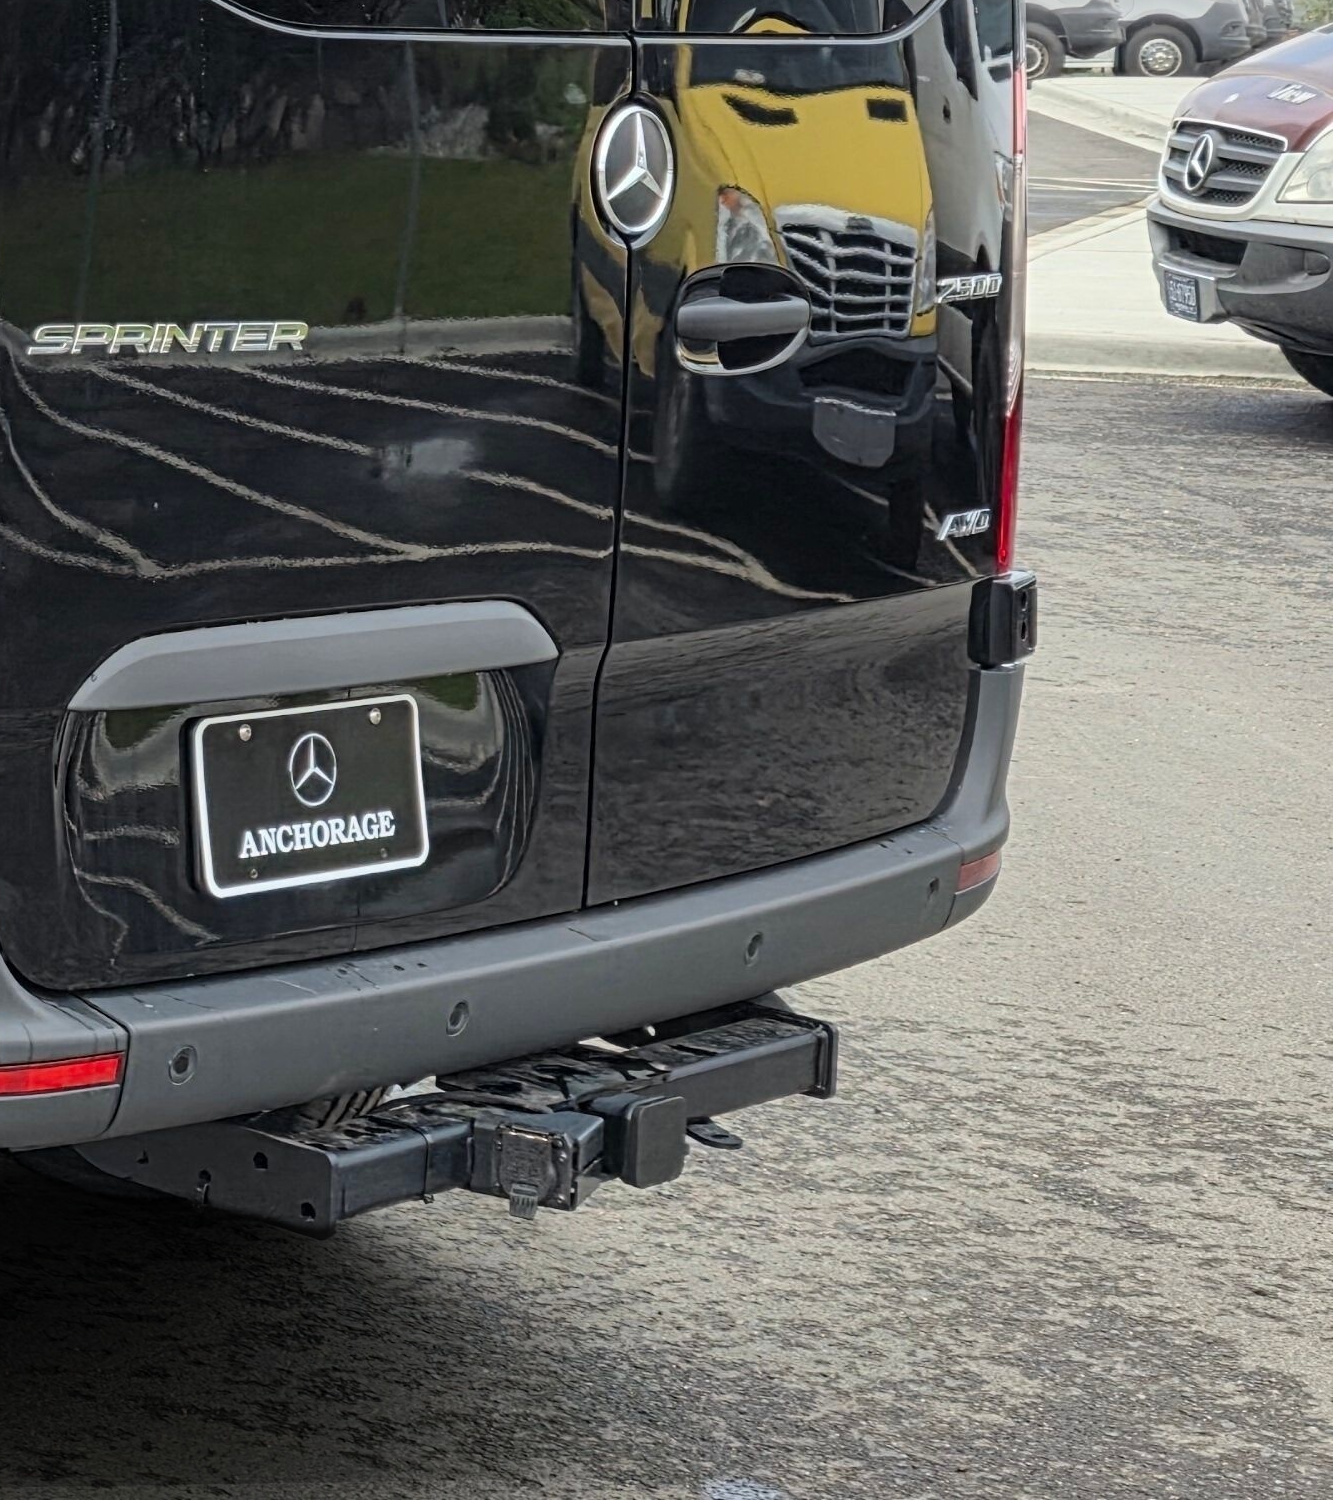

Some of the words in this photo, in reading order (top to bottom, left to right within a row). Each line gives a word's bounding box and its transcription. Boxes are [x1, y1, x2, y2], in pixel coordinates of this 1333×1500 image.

[934, 272, 1003, 304] 2500
[27, 321, 310, 355] SPRINTER
[238, 810, 396, 859] ANCHORAGE
